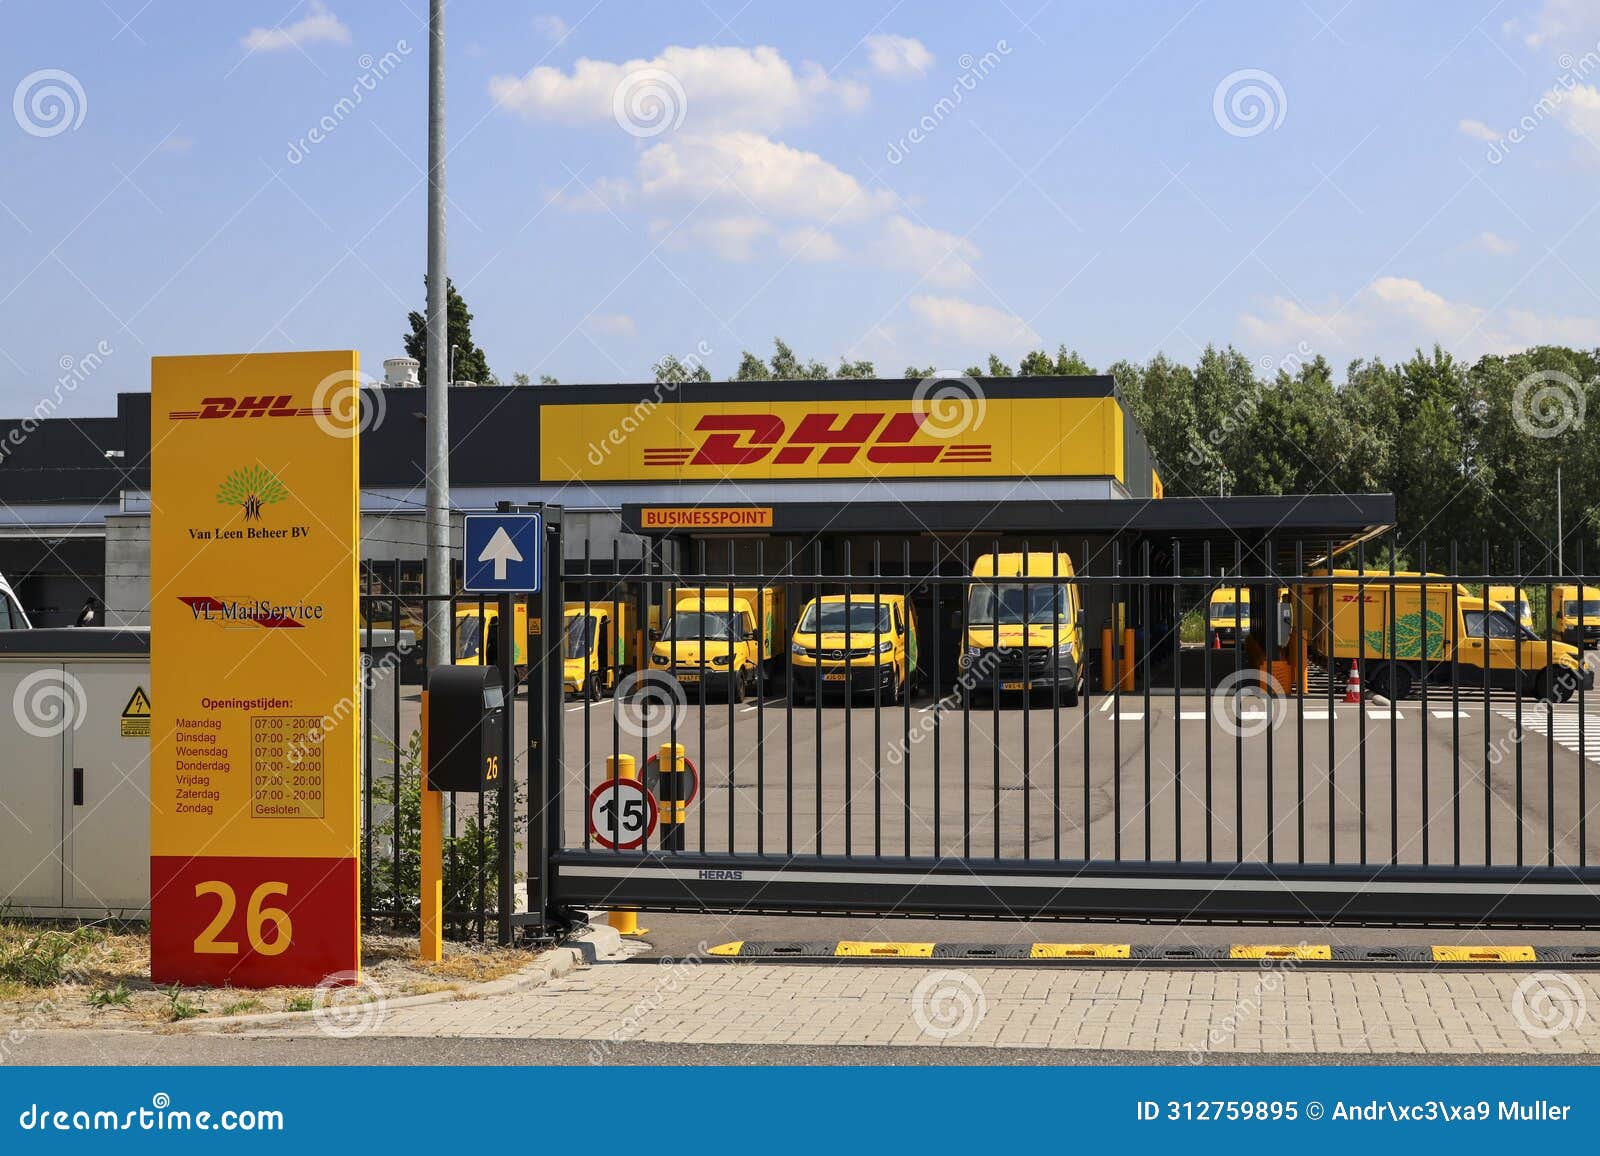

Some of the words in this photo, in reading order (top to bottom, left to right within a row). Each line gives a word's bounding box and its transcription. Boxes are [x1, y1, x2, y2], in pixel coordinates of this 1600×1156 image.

[199, 395, 298, 419] DHL
[689, 412, 943, 466] DHL
[646, 509, 767, 528] BUSINESSPOINT
[189, 528, 211, 540] Van
[214, 528, 243, 540] Leen
[247, 527, 288, 539] Beheer
[291, 526, 310, 538] BV
[190, 602, 215, 620] VL
[221, 600, 323, 620] MailService
[201, 698, 293, 710] Openingstijden:
[176, 718, 222, 730] Maandag
[255, 719, 283, 729] 07:00
[293, 719, 321, 729] 20:00
[176, 732, 216, 744] Dinsdag
[255, 733, 283, 743] 07:00
[176, 747, 228, 759] Woensdag
[255, 747, 283, 757] 07:00
[176, 761, 230, 773] Donderdag
[255, 761, 283, 772] 07:00
[293, 761, 321, 772] 20:00
[486, 755, 499, 780] 26
[175, 775, 210, 788] Vrijdag
[255, 776, 283, 786] 07:00
[293, 776, 321, 786] 20:00
[175, 789, 220, 801] Zaterdag
[255, 790, 283, 800] 07:00
[293, 790, 321, 800] 20:00
[175, 803, 213, 815] Zondag
[255, 804, 300, 815] Gesloten
[600, 799, 644, 832] 15
[698, 870, 743, 880] HERAS
[193, 880, 292, 956] 26
